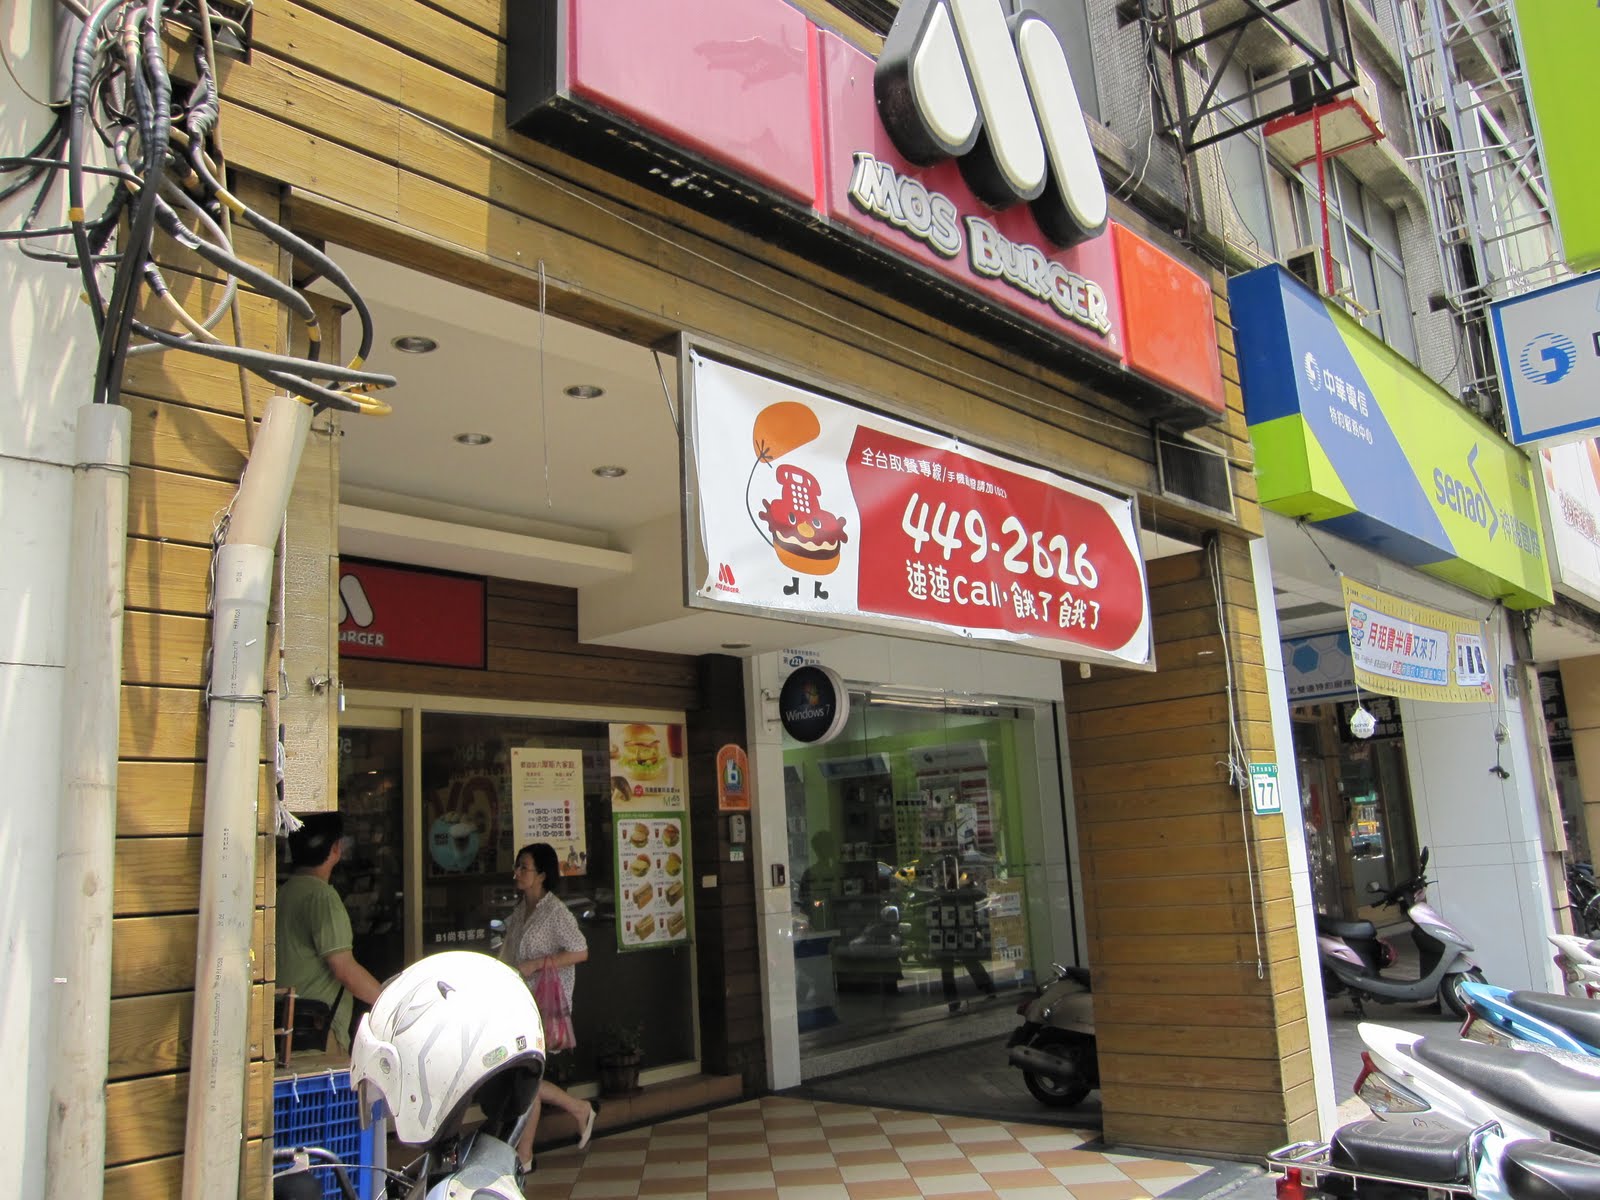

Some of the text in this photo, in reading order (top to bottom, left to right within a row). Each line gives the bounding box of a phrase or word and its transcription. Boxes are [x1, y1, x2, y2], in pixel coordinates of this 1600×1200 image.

[849, 152, 1112, 337] MOS BURGER
[1323, 368, 1368, 417] 中華電信
[1329, 405, 1373, 445] 特約服務中心
[1433, 467, 1487, 529] senao
[339, 631, 384, 647] URGER
[786, 704, 831, 721] Windows 7
[1258, 783, 1273, 805] 77
